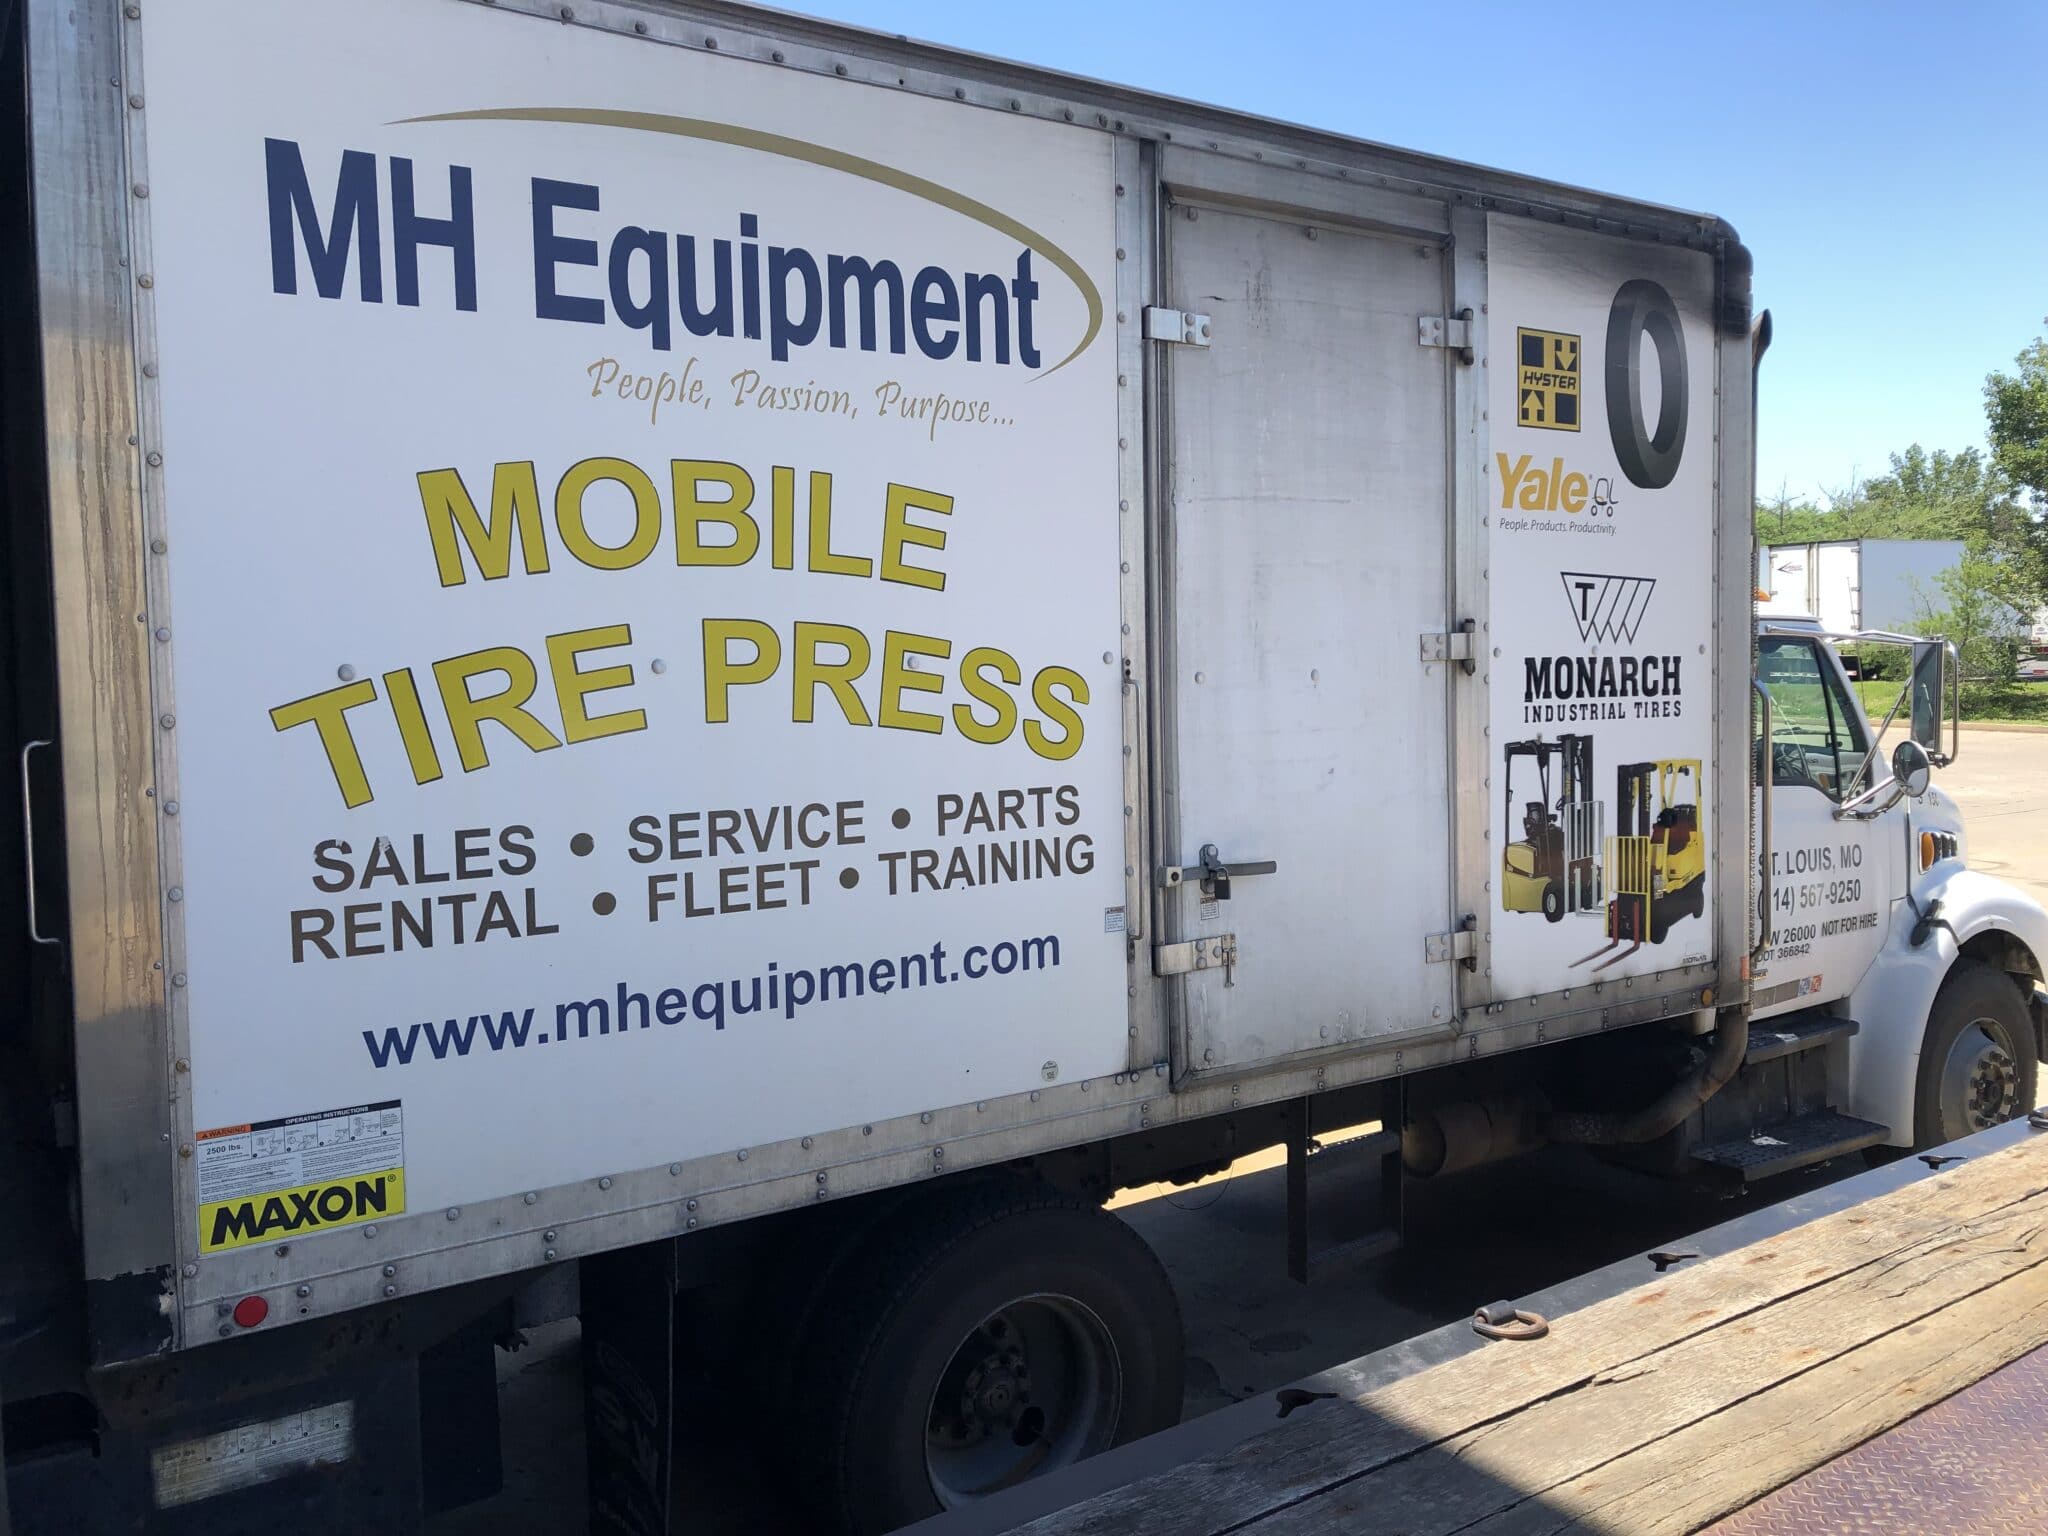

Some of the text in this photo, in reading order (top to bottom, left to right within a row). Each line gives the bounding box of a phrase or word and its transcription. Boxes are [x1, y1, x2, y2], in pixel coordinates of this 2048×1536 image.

[264, 137, 1041, 369] MH Equipment
[587, 357, 1015, 442] People, Passion, Purpose...
[1523, 370, 1577, 390] HYSTER
[1496, 452, 1589, 514] Yale
[416, 457, 954, 592] MOBILE
[1499, 517, 1616, 536] People. Products. Productivity.
[1574, 582, 1595, 621] T
[1524, 656, 1681, 702] MONARCH
[268, 618, 1091, 810] TIRE PRESS
[1524, 700, 1681, 723] INDUSTRIAL TIRES
[312, 784, 1081, 894] SALES SERVICE PARTS
[1786, 847, 1836, 874] LOUIS,
[1840, 843, 1862, 869] MO
[290, 833, 1095, 964] RENTAL FLEET TRAINING
[1758, 878, 1861, 920] (14) 567-9250
[1777, 943, 1810, 959] 366842
[1783, 924, 1816, 944] 26000
[1822, 919, 1839, 937] NOT
[1841, 915, 1858, 934] FOR
[1860, 912, 1878, 930] HIRE
[363, 933, 1061, 1069] www.mhequipment.com
[206, 1145, 226, 1156] 2500
[210, 1177, 386, 1247] MAXON
